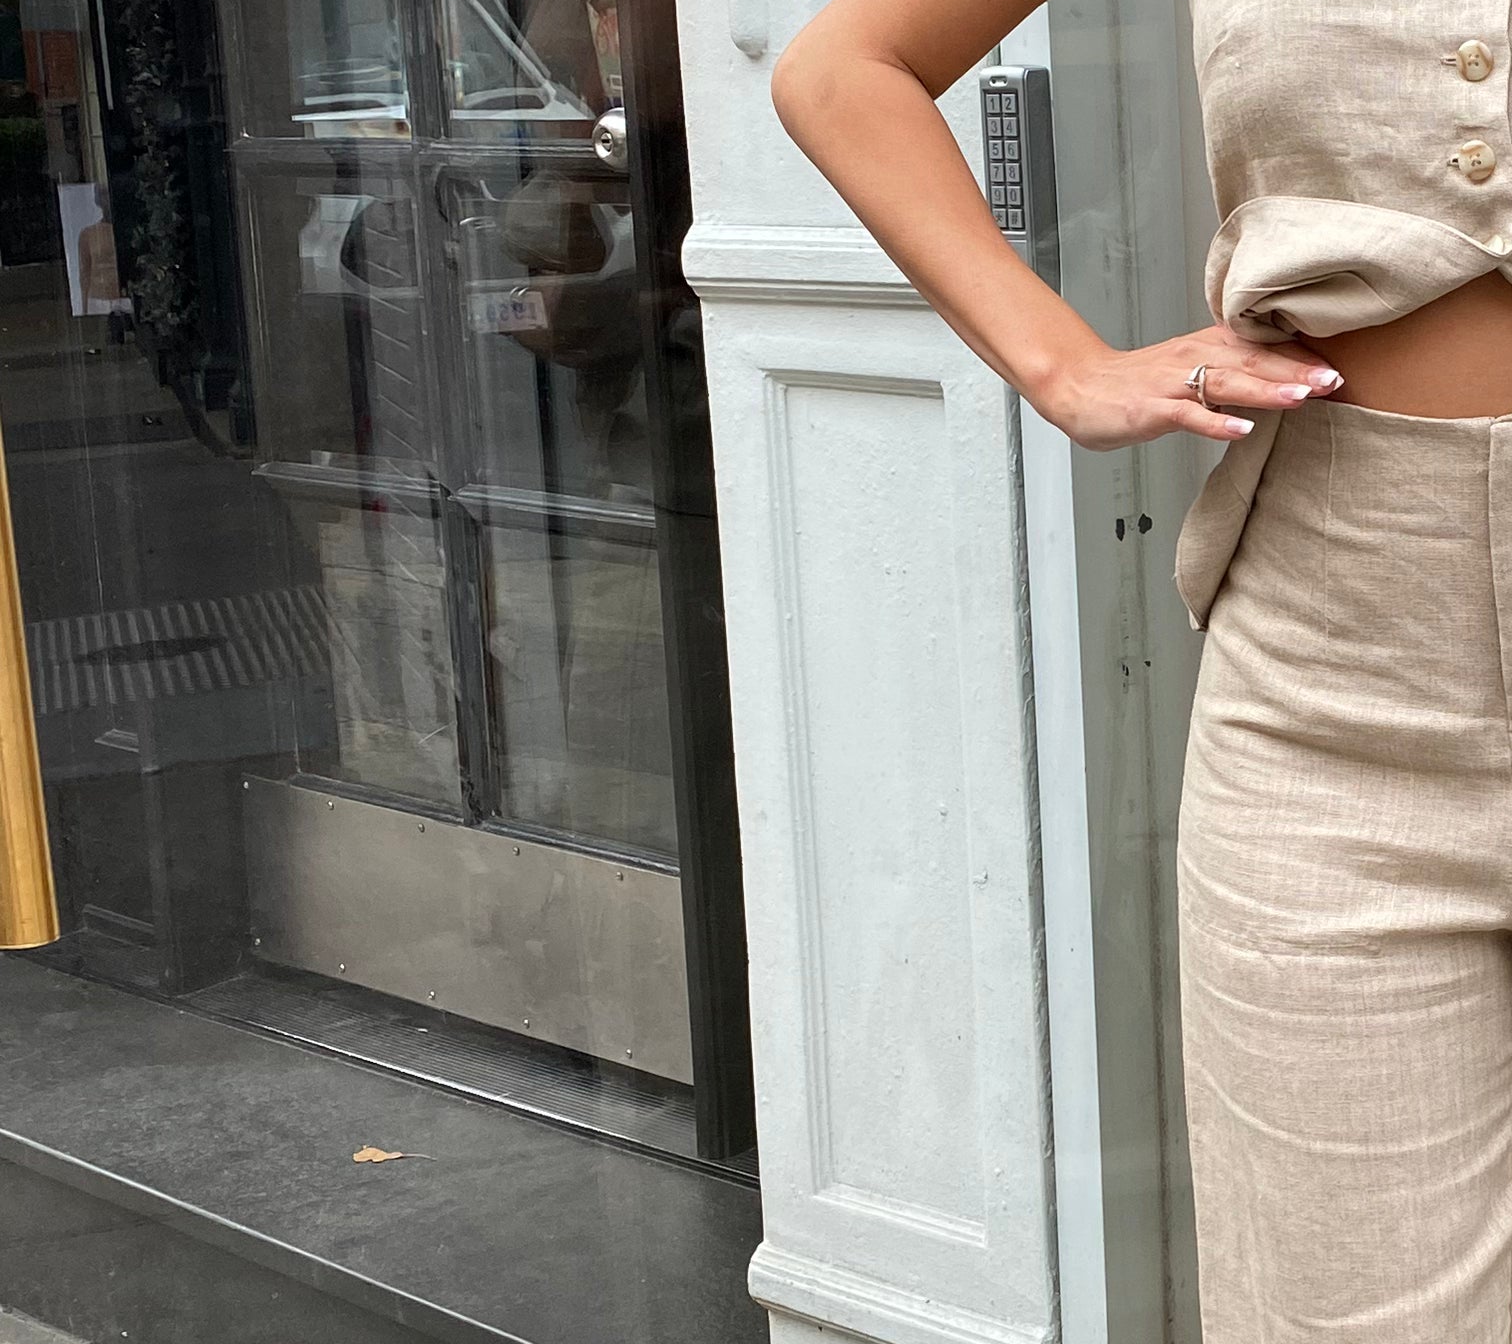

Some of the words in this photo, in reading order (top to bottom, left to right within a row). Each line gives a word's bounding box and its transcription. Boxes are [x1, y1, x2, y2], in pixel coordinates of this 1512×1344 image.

[990, 98, 995, 110] 1
[1005, 97, 1011, 110] 2
[991, 121, 997, 133] 3
[1006, 120, 1013, 133] 4
[992, 143, 999, 156] 5
[1008, 143, 1014, 156] 6
[994, 166, 1000, 179] 7
[1009, 166, 1015, 178] 8
[995, 190, 1001, 202] 9
[1010, 189, 1016, 201] 0
